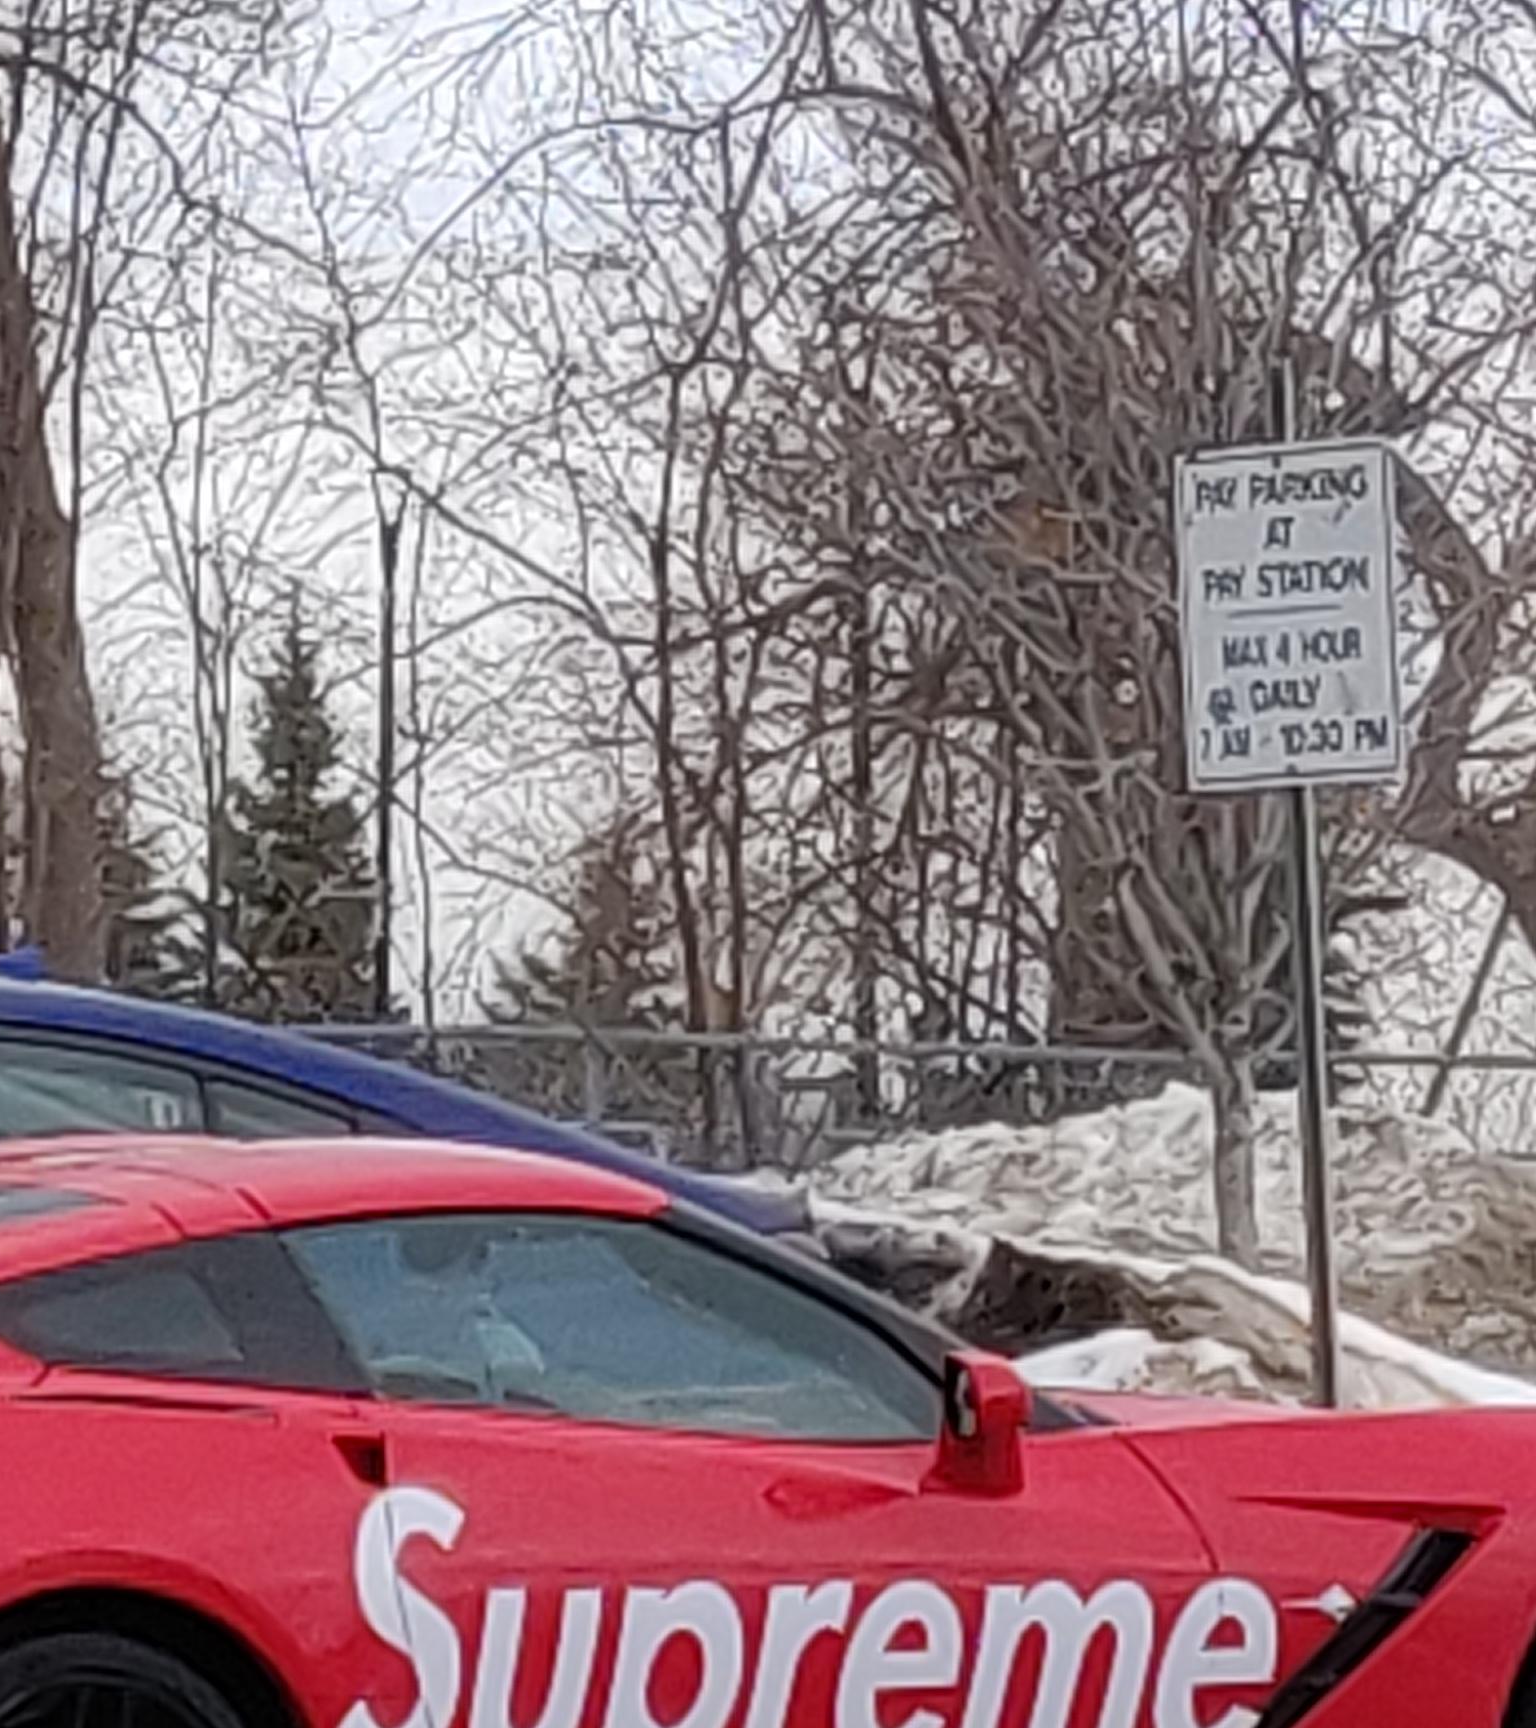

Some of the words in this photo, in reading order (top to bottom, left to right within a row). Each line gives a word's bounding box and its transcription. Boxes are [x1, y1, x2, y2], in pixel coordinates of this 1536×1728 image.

[1249, 464, 1368, 508] PARKING
[1263, 516, 1295, 549] AT
[1202, 564, 1246, 601] PAY
[1257, 556, 1369, 597] STATION
[1222, 635, 1268, 669] MAX
[1298, 627, 1362, 663] HOUR
[1355, 715, 1388, 750] PM
